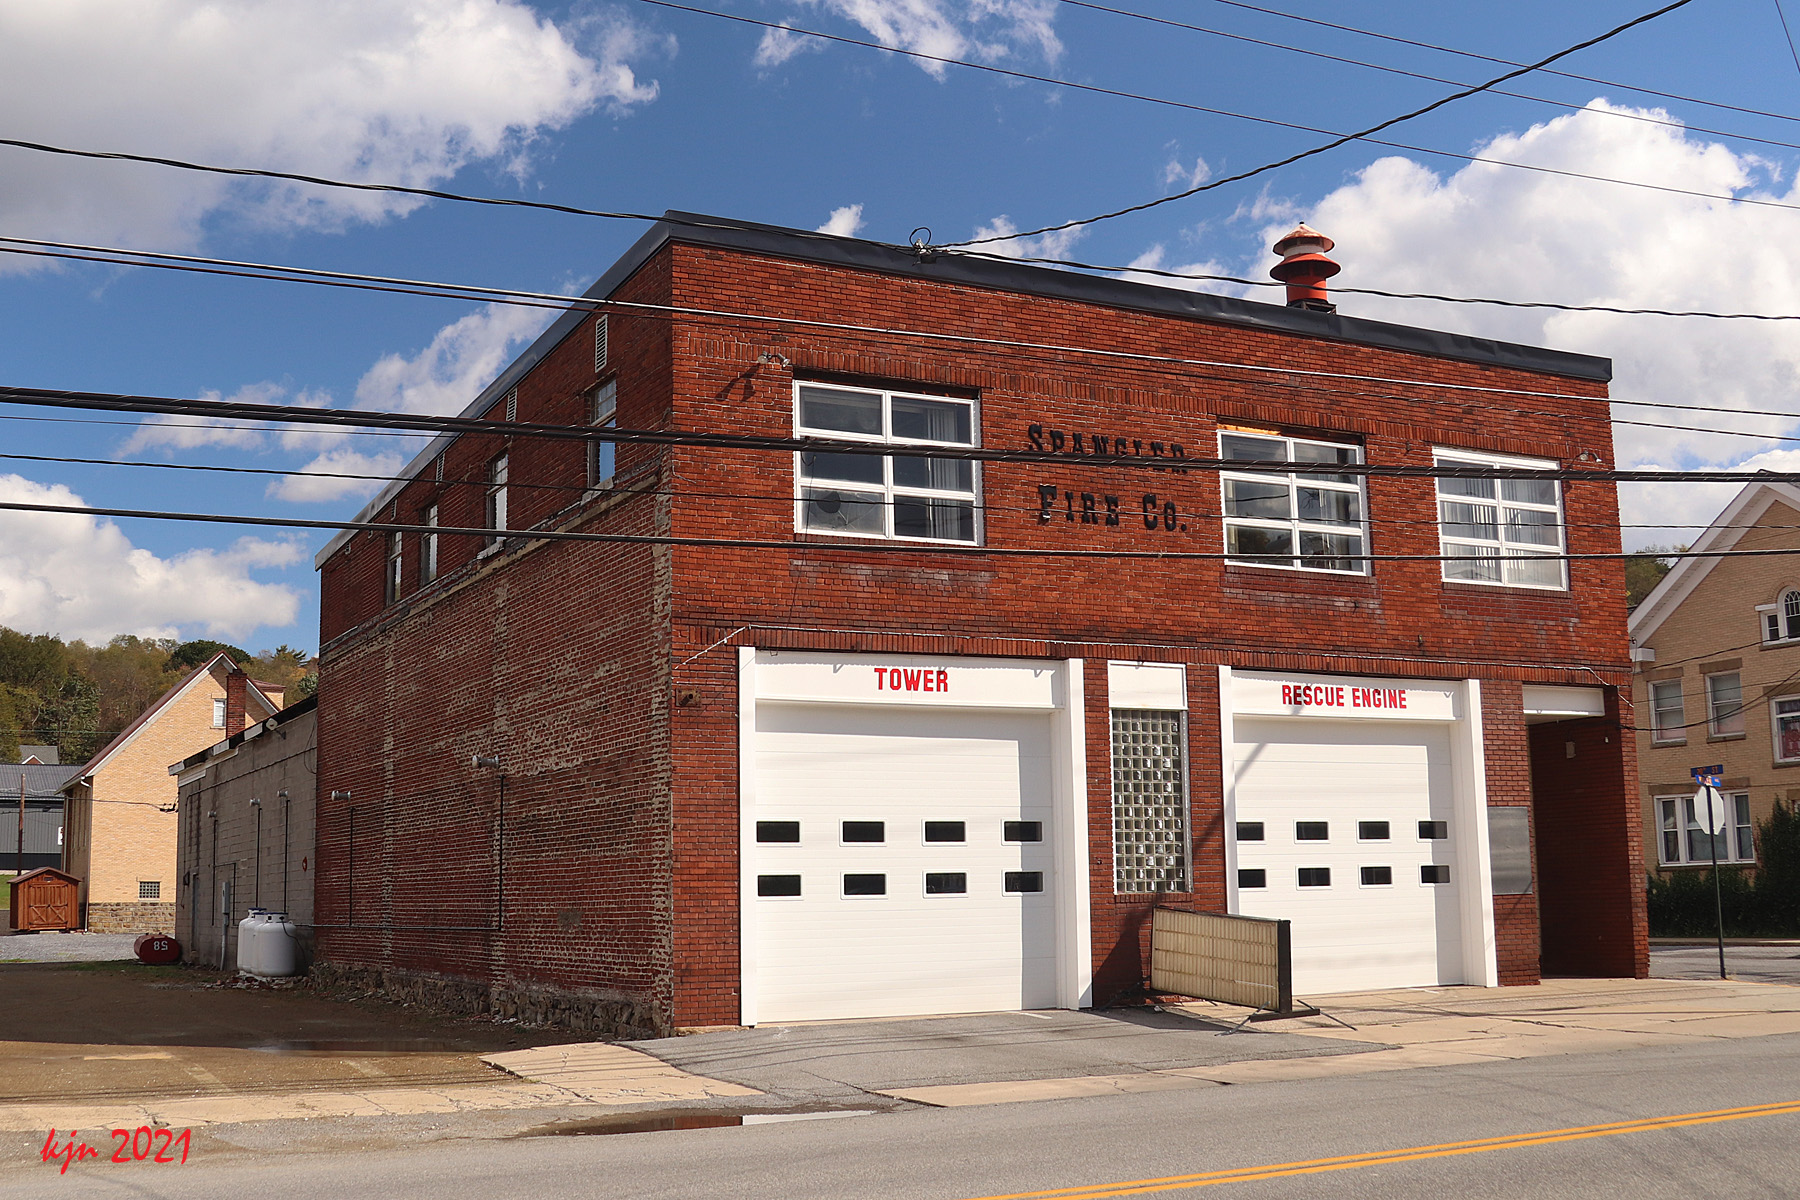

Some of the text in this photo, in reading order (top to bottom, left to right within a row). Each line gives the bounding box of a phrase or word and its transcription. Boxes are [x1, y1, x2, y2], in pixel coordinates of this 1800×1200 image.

[1038, 484, 1187, 531] FIRE CO.
[874, 667, 948, 692] TOWER
[1281, 684, 1407, 709] RESCUE ENGINE
